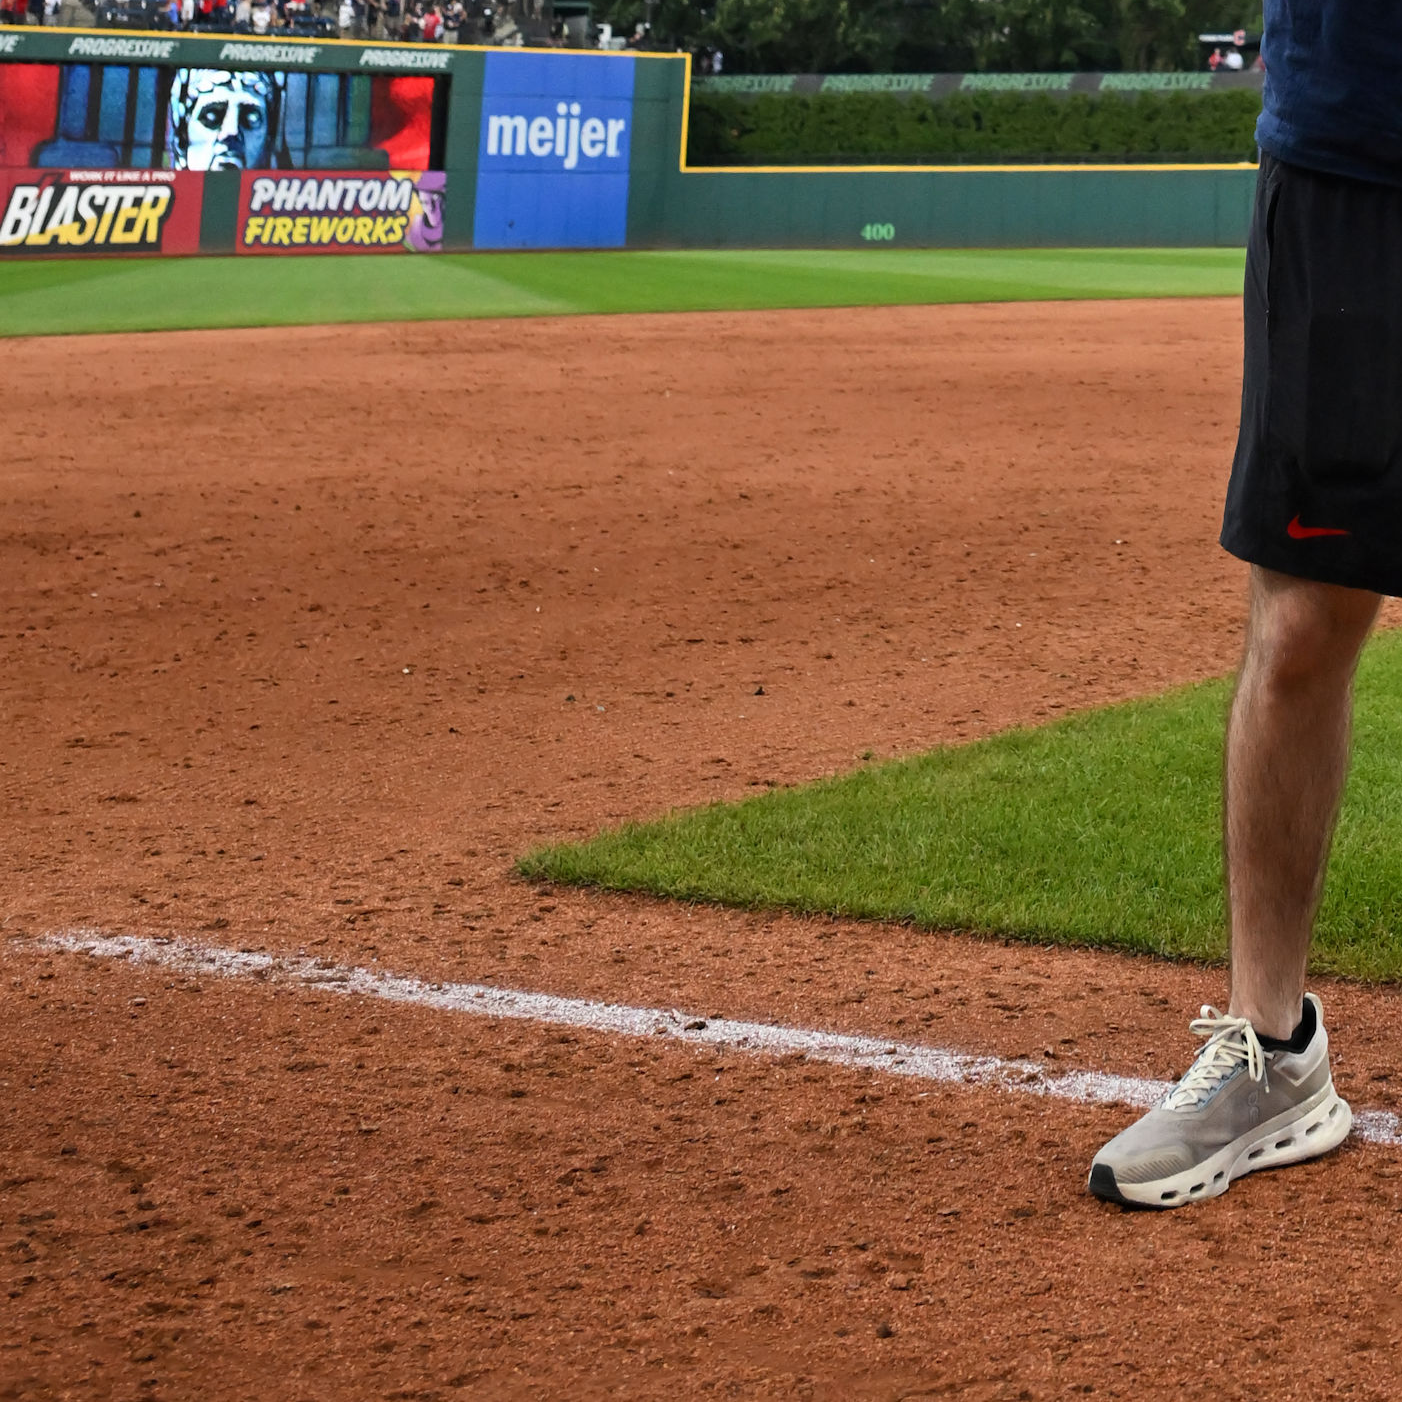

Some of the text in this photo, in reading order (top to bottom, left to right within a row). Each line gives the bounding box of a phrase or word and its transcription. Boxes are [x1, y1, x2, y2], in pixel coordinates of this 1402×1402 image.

[69, 36, 174, 59] PROGRESSIVE
[219, 43, 318, 64] PROGRESSIVE
[359, 48, 451, 69] PROGRESSIVE
[487, 101, 625, 170] meijer
[250, 177, 413, 211] PHANTOM
[0, 185, 171, 245] BLASTER
[244, 216, 408, 245] FIREWORKS
[860, 222, 895, 241] 400
